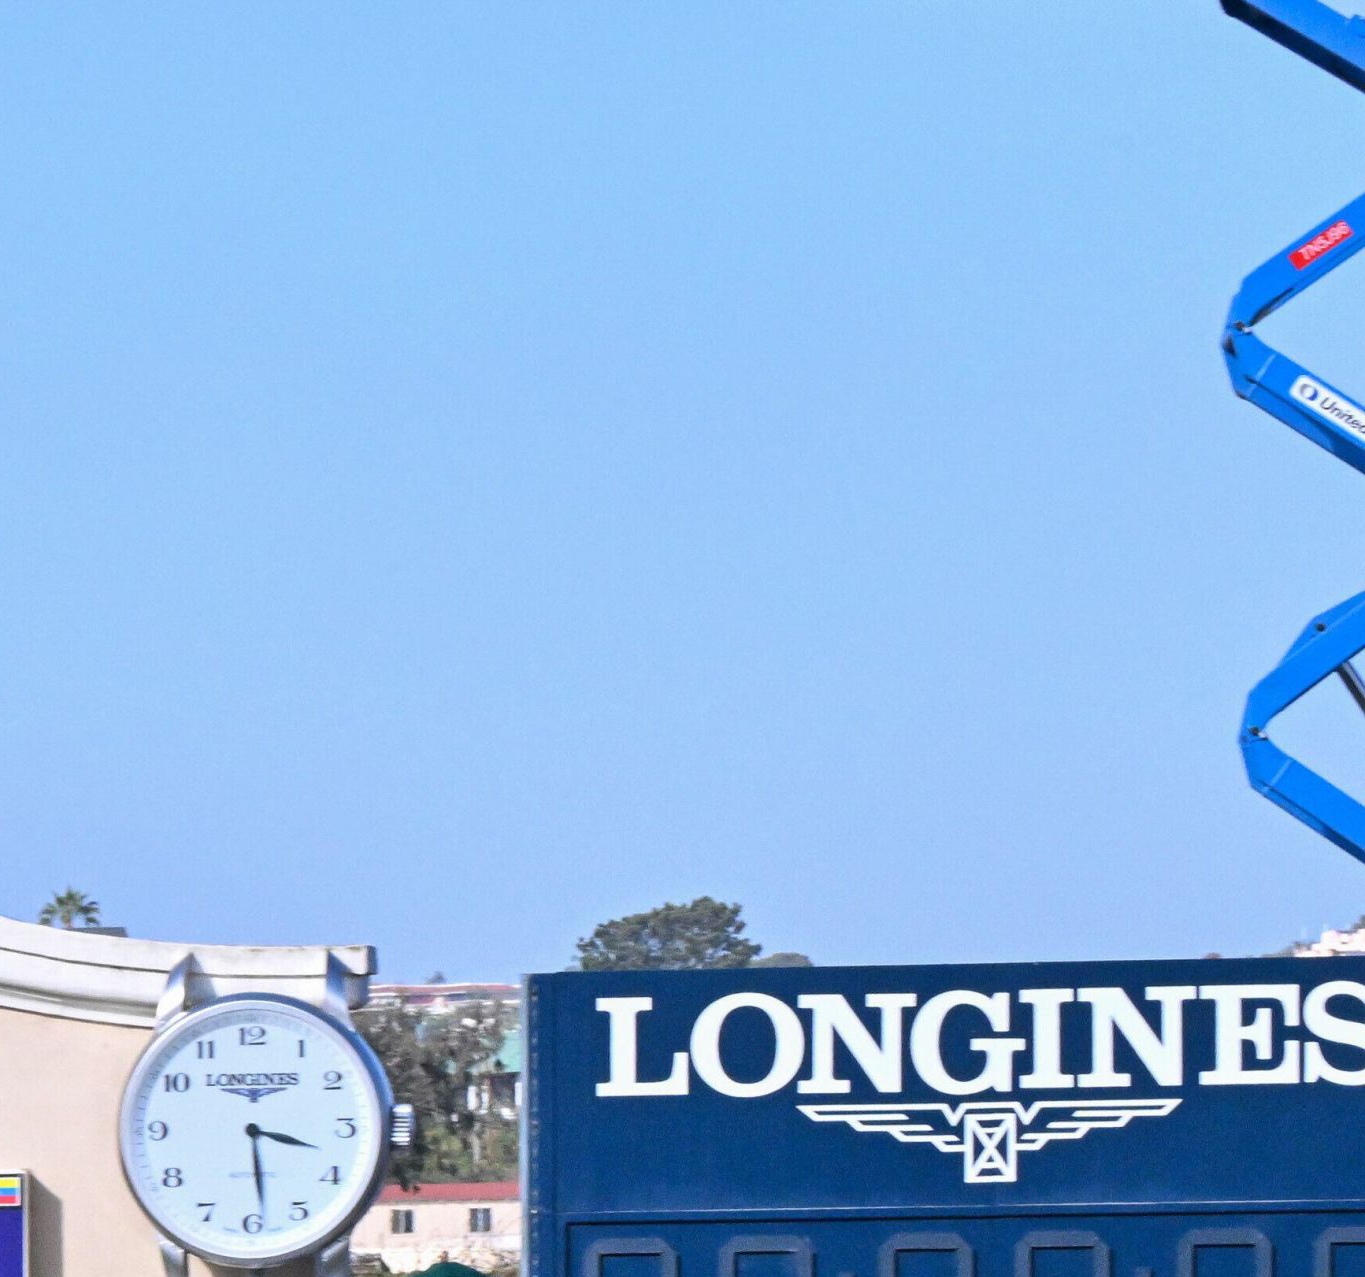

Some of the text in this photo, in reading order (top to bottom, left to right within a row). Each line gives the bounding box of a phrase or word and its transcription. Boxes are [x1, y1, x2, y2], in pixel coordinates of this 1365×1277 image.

[238, 1026, 267, 1046] 12
[595, 980, 1365, 1098] LONGINES
[196, 1040, 216, 1059] 11
[297, 1039, 306, 1058] 1
[163, 1073, 190, 1092] 10
[205, 1072, 299, 1087] LONGINES
[323, 1070, 343, 1090] 2
[147, 1121, 168, 1141] 9
[335, 1117, 357, 1138] 3
[162, 1167, 183, 1188] 8
[319, 1165, 342, 1185] 4
[196, 1202, 216, 1222] 7
[289, 1201, 309, 1221] 5
[242, 1213, 263, 1234] 6
